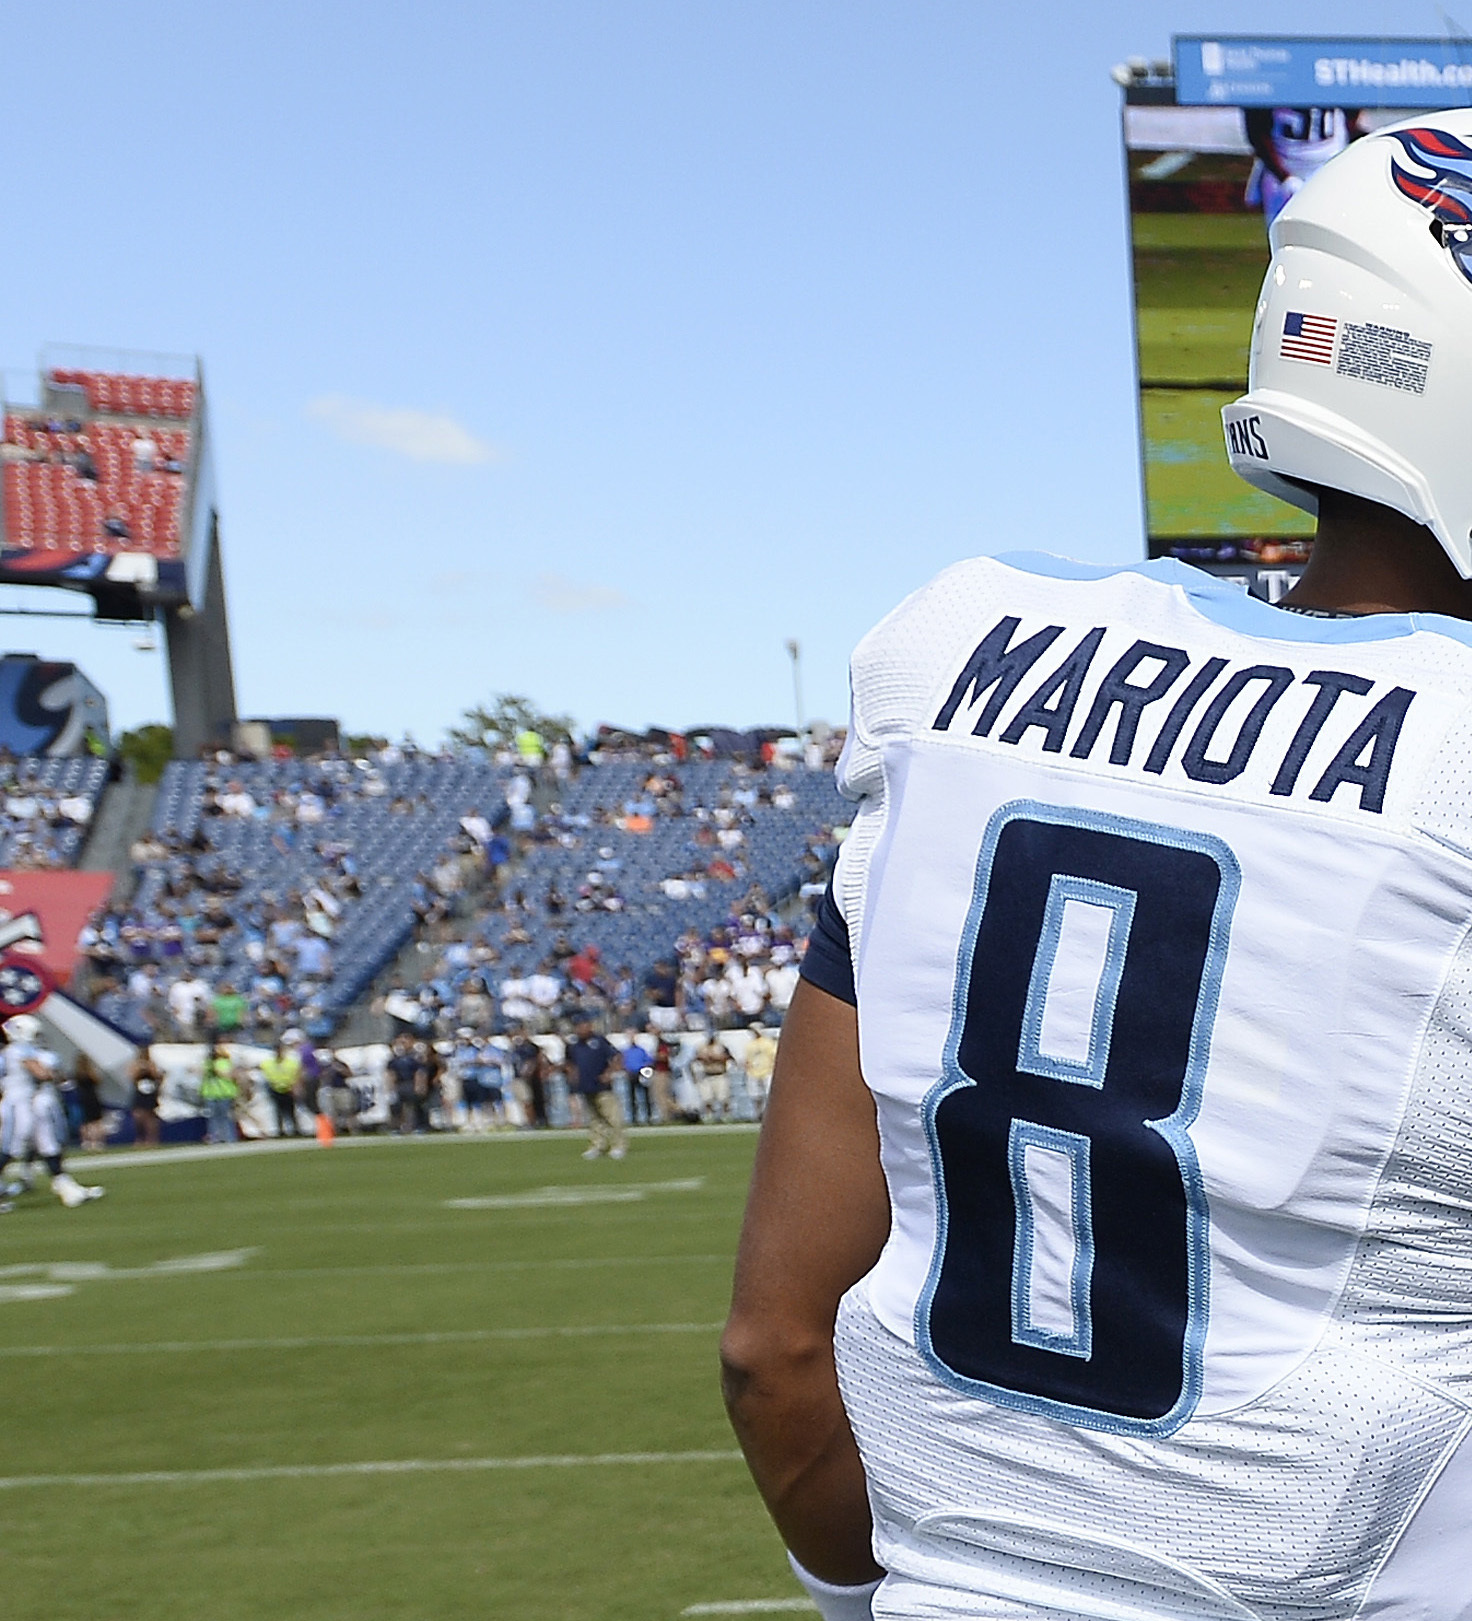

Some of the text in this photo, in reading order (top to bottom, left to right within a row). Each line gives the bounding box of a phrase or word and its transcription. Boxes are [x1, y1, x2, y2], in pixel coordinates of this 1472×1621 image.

[1225, 415, 1269, 461] ANS
[931, 615, 1418, 814] MARIOTA
[914, 798, 1242, 1439] 8
